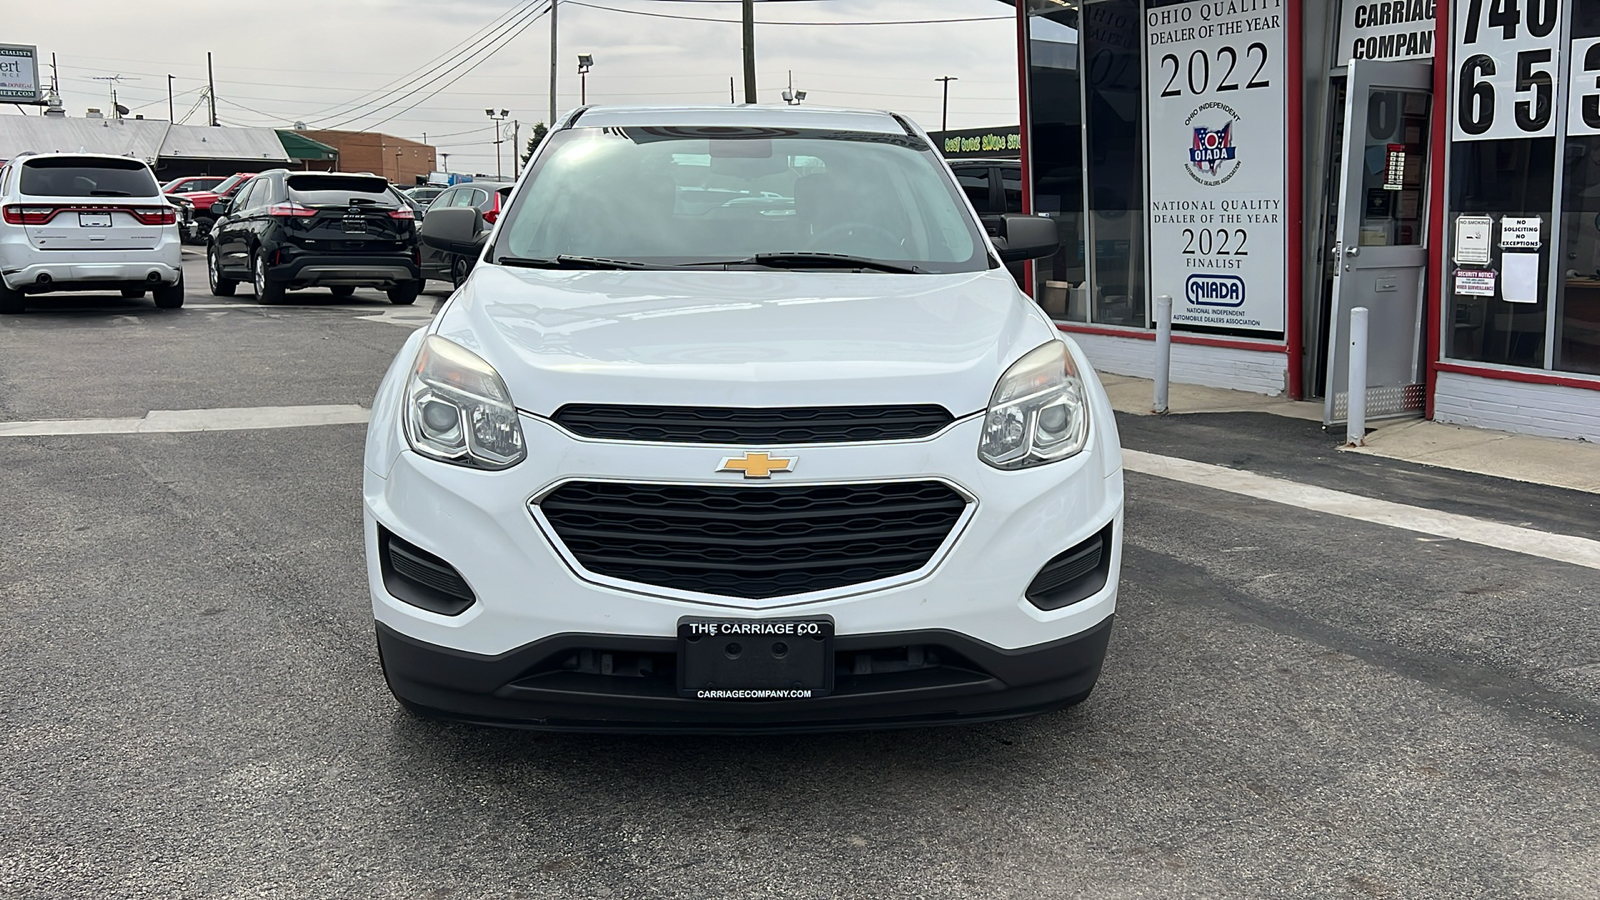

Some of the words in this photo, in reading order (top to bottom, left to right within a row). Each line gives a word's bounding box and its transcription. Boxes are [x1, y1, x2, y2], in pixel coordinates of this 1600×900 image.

[1149, 7, 1191, 27] OHIO
[1150, 28, 1195, 45] DEALER
[1198, 25, 1214, 39] OF
[1217, 21, 1242, 36] THE
[1246, 15, 1280, 31] YEAR
[1353, 30, 1435, 60] COMPAN
[1160, 42, 1270, 97] 2022
[1185, 109, 1198, 126] OHIO
[1199, 102, 1241, 121] INDEPENDENT
[1195, 148, 1228, 160] OIADA
[1153, 201, 1215, 211] NATIONAL
[1221, 200, 1280, 212] QUALITY
[1154, 214, 1195, 223] DEALER
[1200, 214, 1214, 223] OF
[1220, 214, 1241, 223] THE
[1247, 214, 1279, 223] YEAR
[1182, 228, 1248, 256] 2022
[1186, 258, 1242, 269] FINALIST
[1190, 281, 1239, 300] NIADA
[1187, 307, 1210, 315] NATIONAL
[1204, 316, 1225, 324] DEALERS
[1226, 318, 1260, 326] ASSOCIATION
[690, 623, 717, 634] THE
[721, 623, 794, 634] CARRIAGE
[797, 623, 821, 634] CO.
[697, 690, 811, 698] CARRIAGECOMPANY.COM
